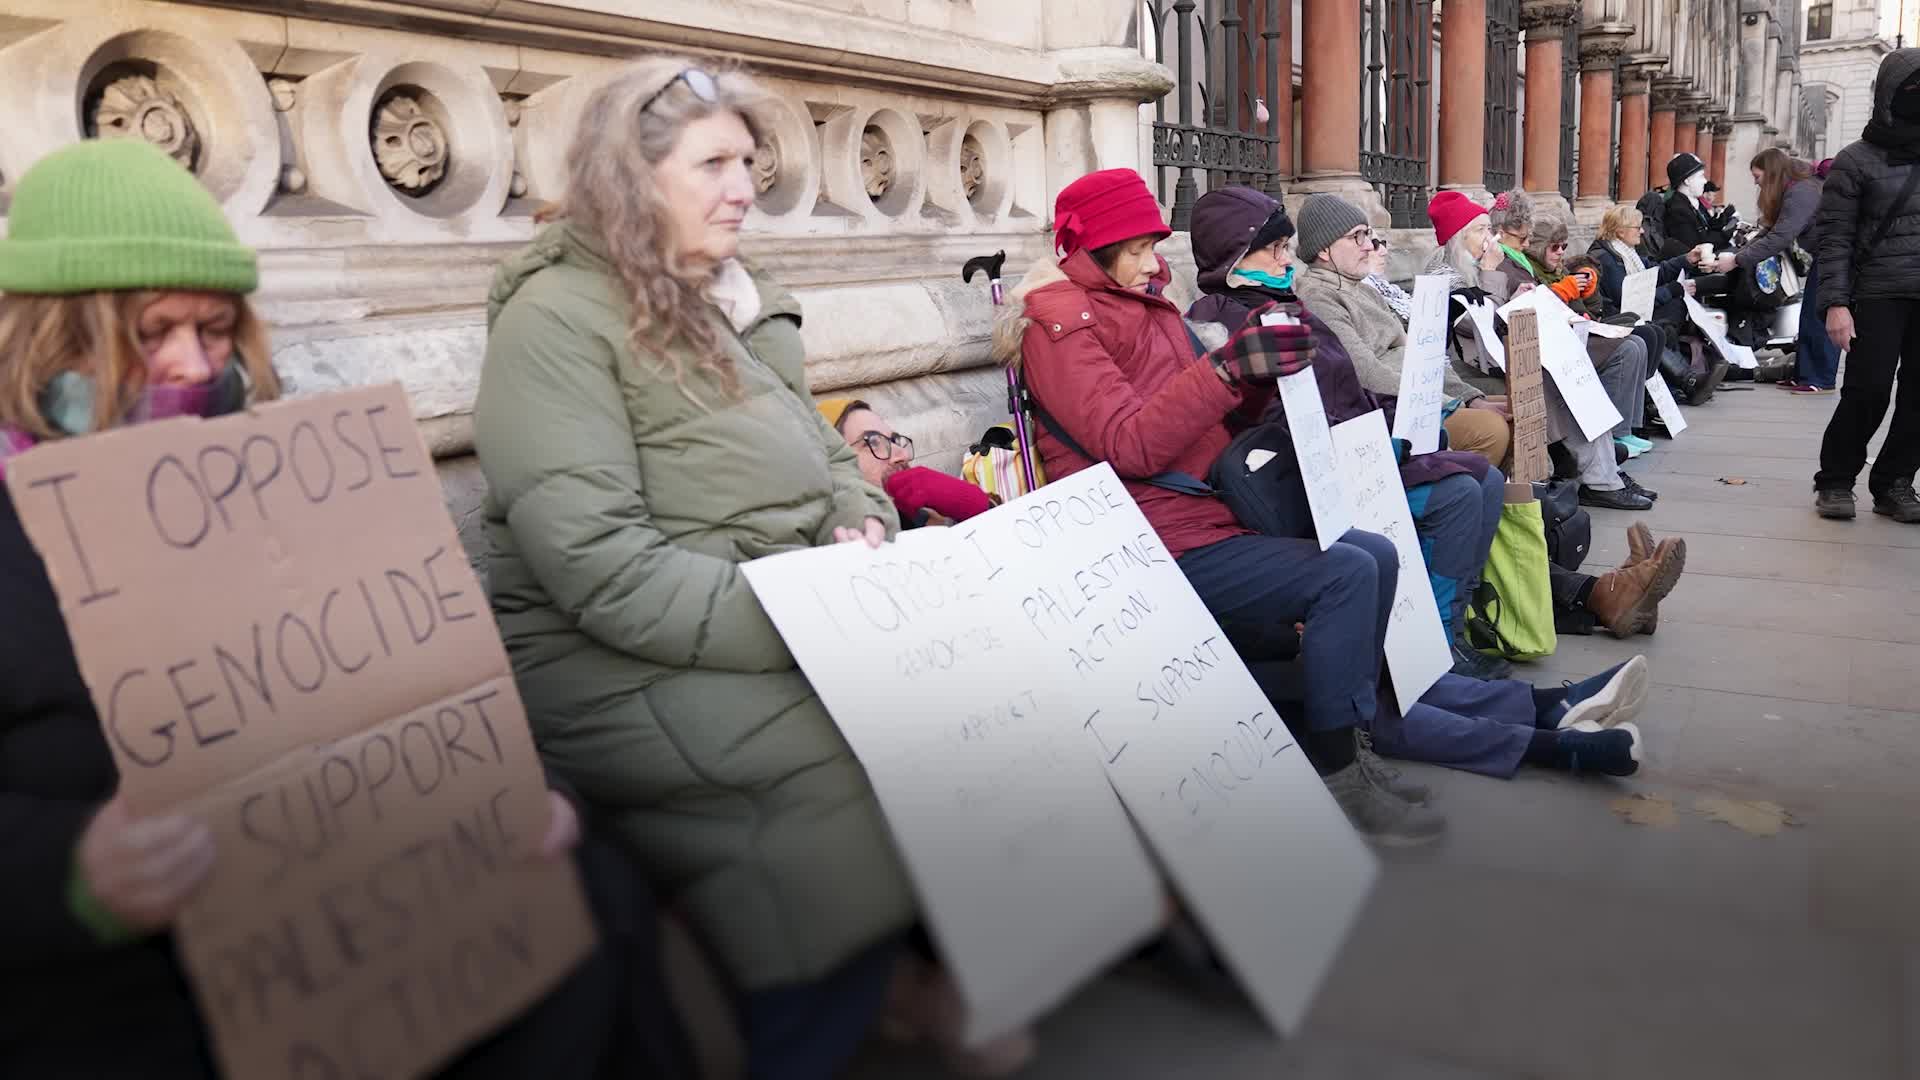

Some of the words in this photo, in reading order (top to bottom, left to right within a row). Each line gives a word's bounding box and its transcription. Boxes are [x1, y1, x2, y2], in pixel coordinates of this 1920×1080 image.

[28, 470, 121, 607] I
[145, 404, 420, 550] OPPOSE
[963, 529, 1004, 581] I
[1015, 480, 1124, 548] OPPOSE
[1022, 532, 1168, 640] PALESTINE
[107, 546, 477, 768] GENOCIDE
[1083, 708, 1129, 765] I
[1136, 636, 1220, 721] SUPPORT
[239, 689, 508, 884] SUPPORT
